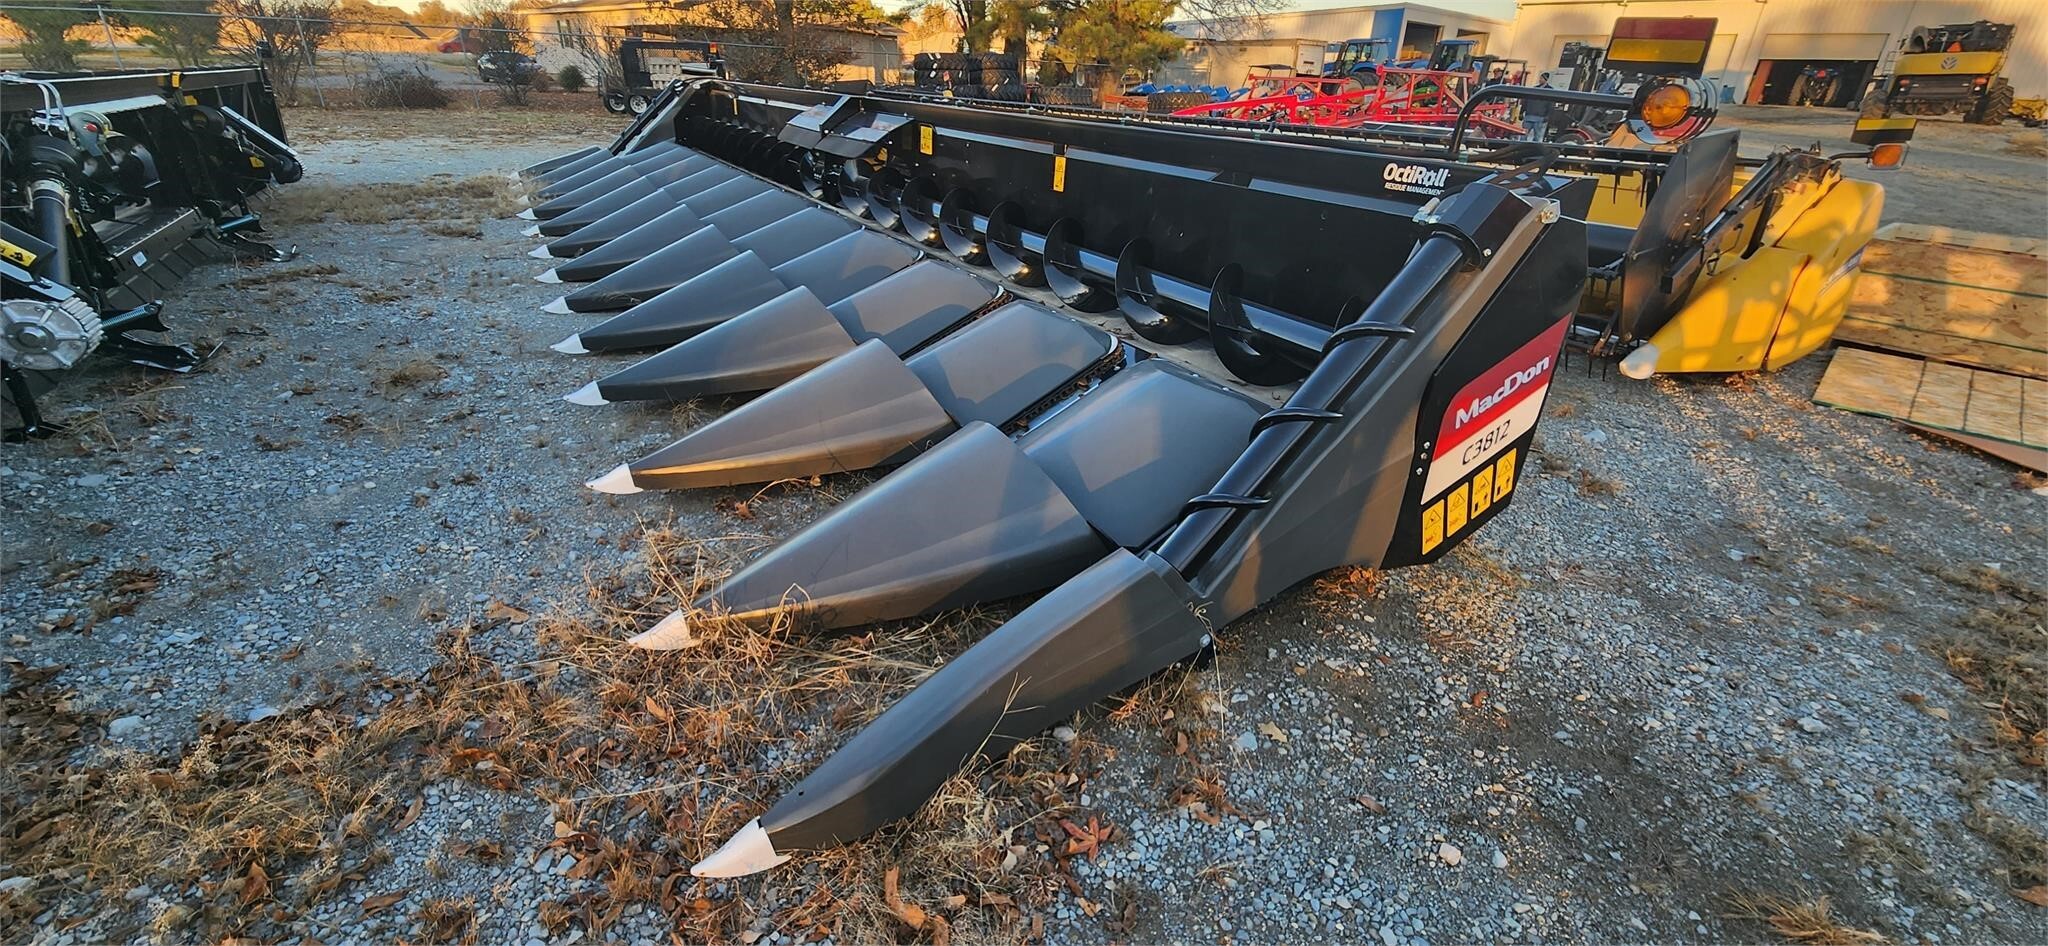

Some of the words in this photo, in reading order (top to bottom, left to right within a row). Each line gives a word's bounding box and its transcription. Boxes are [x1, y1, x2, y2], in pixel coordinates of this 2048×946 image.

[1383, 163, 1449, 187] OctiRoll
[1384, 182, 1407, 191] RESIDUE
[1455, 356, 1550, 429] MacDon
[1462, 419, 1511, 465] C3812
